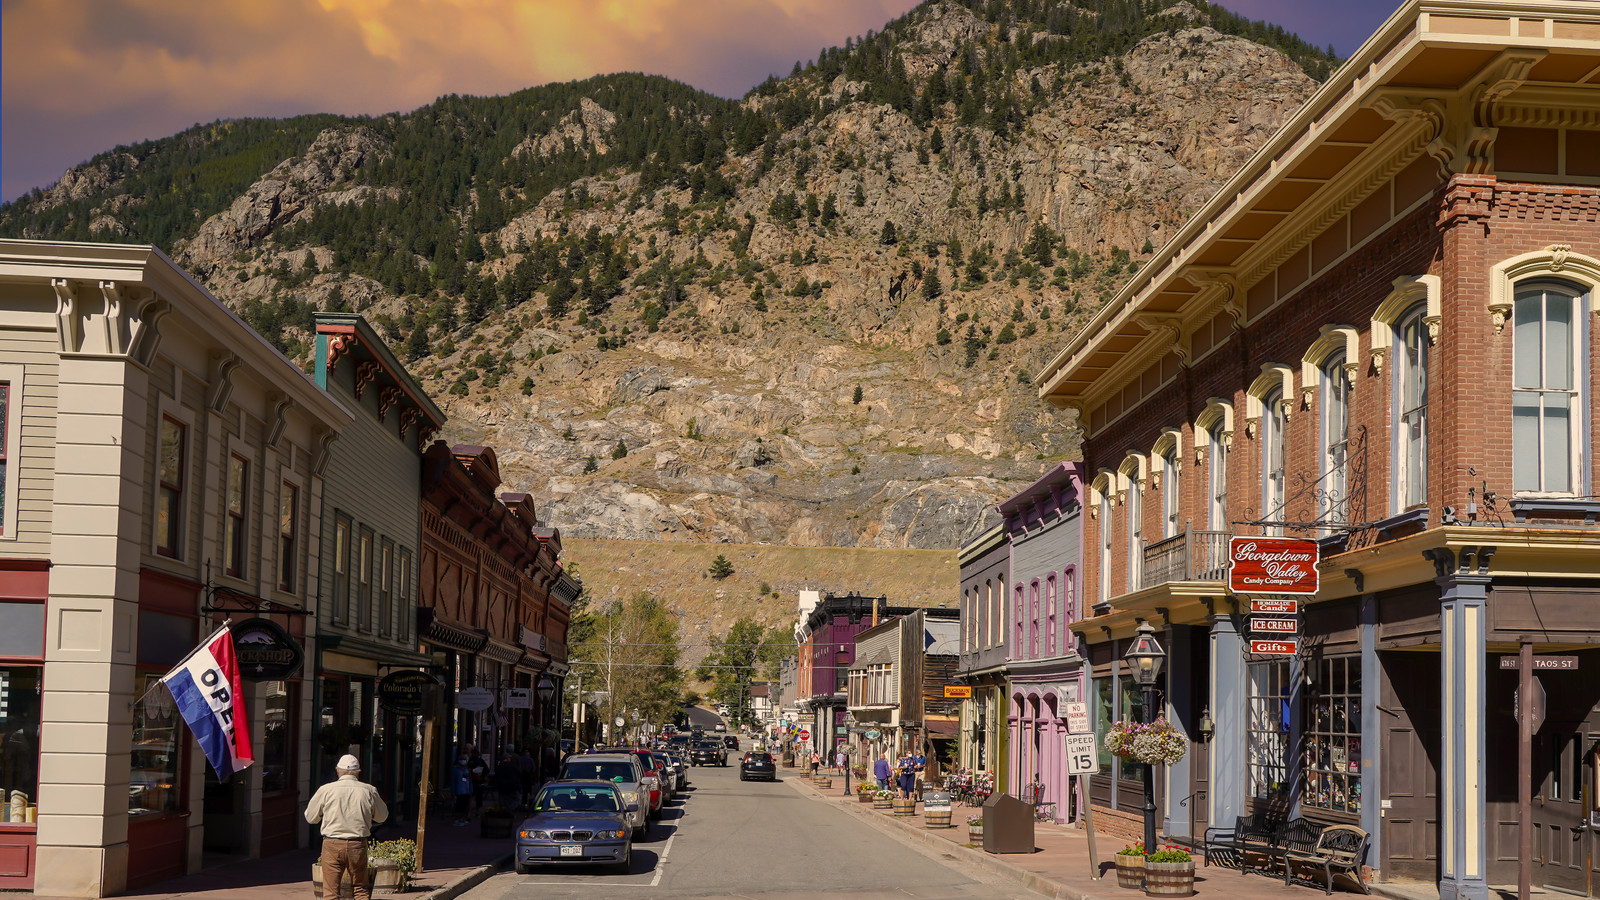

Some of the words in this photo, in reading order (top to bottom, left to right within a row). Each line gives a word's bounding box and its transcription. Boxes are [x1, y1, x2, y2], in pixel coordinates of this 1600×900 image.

[1235, 542, 1312, 568] Georgetown
[1266, 562, 1308, 583] Valley
[1243, 577, 1264, 585] Candy
[1264, 577, 1294, 586] Company
[1253, 620, 1266, 629] ICE
[1267, 621, 1294, 630] CREAM
[1256, 643, 1287, 652] Gifts
[1535, 660, 1558, 668] TAOS
[1561, 660, 1573, 668] ST
[383, 683, 417, 692] Colorado
[1073, 755, 1092, 770] 15
